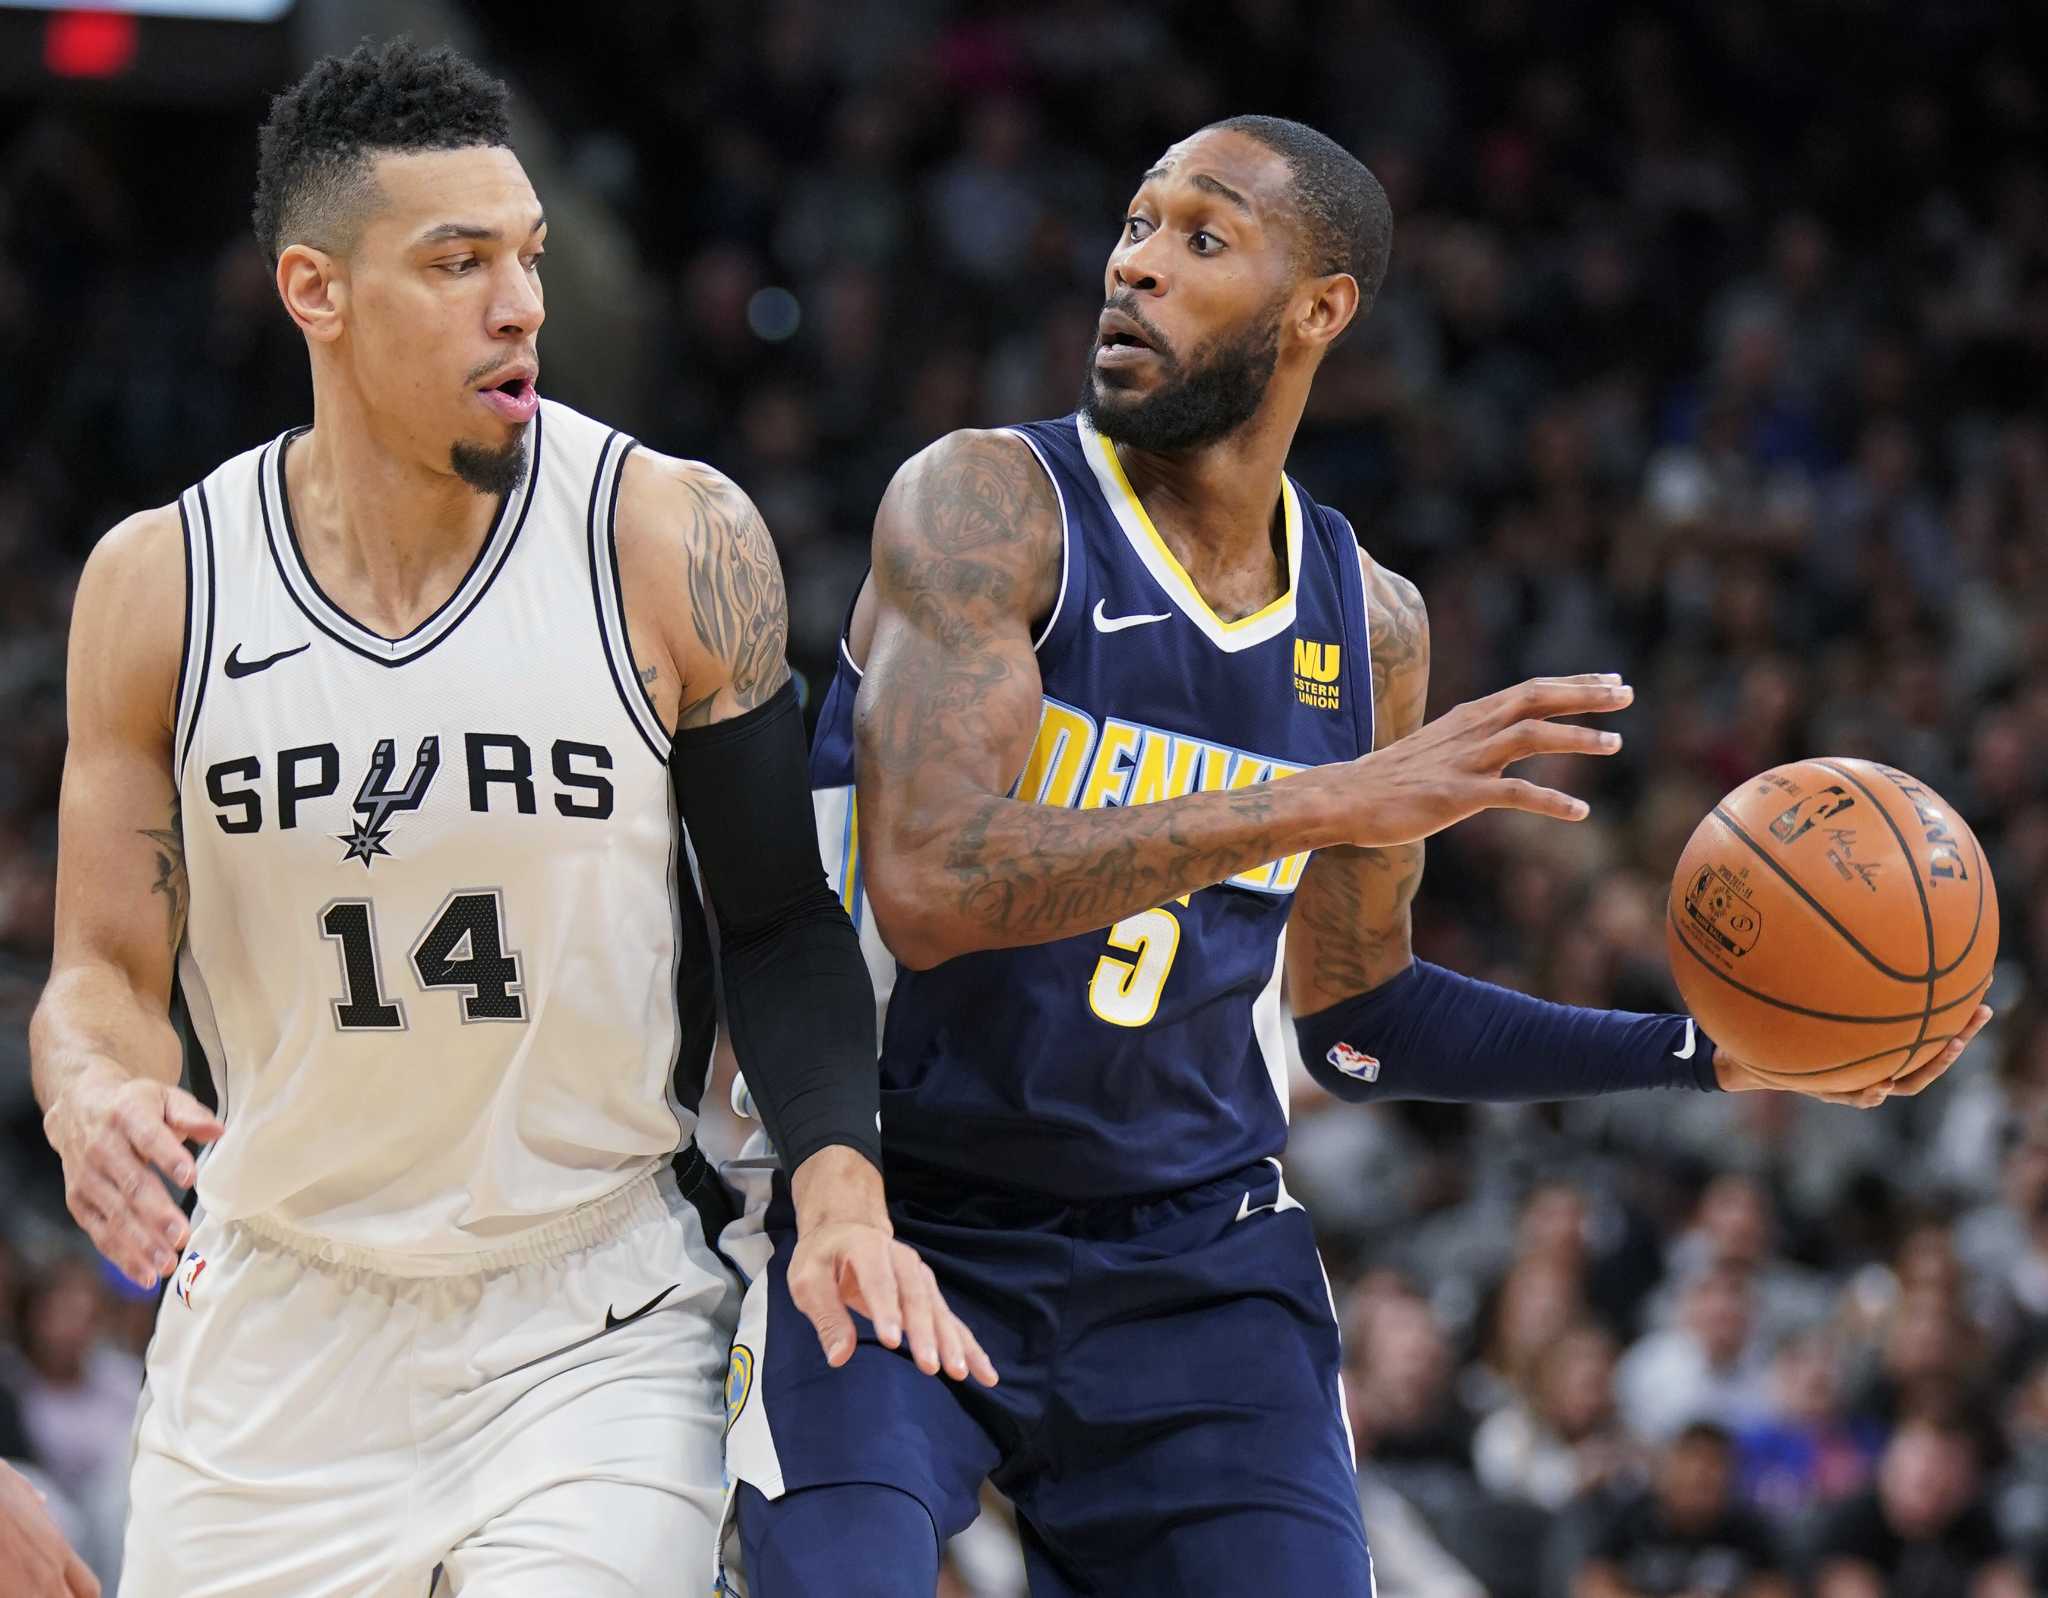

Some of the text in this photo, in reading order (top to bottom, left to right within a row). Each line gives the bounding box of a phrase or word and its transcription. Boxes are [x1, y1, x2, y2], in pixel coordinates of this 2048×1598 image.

[1294, 677, 1340, 698] ESTERN
[1298, 691, 1340, 710] UNION
[205, 732, 615, 868] SPURS
[317, 887, 530, 1031] 14
[1088, 893, 1191, 1028] 5
